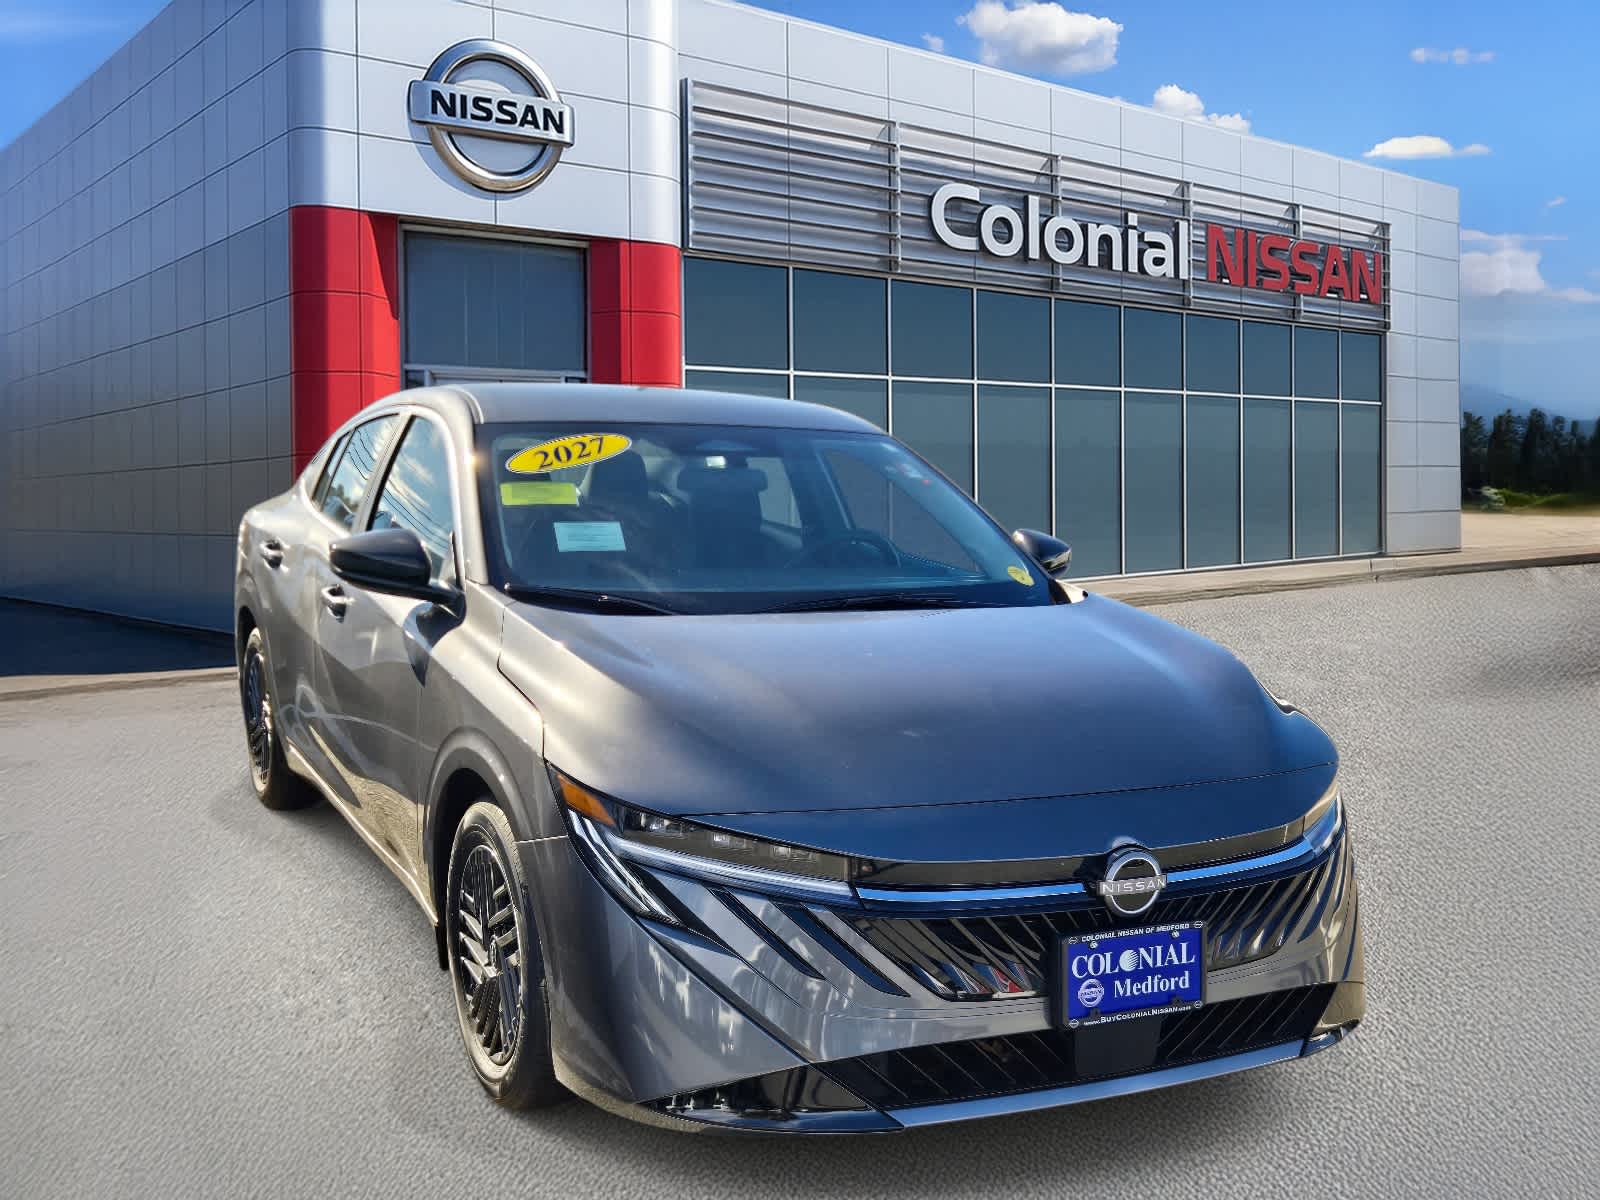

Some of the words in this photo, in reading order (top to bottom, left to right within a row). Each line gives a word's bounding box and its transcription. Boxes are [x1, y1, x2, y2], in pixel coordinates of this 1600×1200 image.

[430, 89, 565, 134] NISSAN
[931, 183, 1189, 280] Colonial
[1205, 223, 1383, 305] NISSAN
[534, 436, 605, 470] 2027
[1102, 877, 1167, 895] NISSAN
[1081, 932, 1117, 943] COLONIAL
[1117, 928, 1144, 938] NISSAN
[1145, 926, 1155, 935] OF
[1156, 922, 1190, 933] MEDFORD
[1071, 942, 1196, 979] COLONIAL
[1114, 971, 1190, 998] Medford
